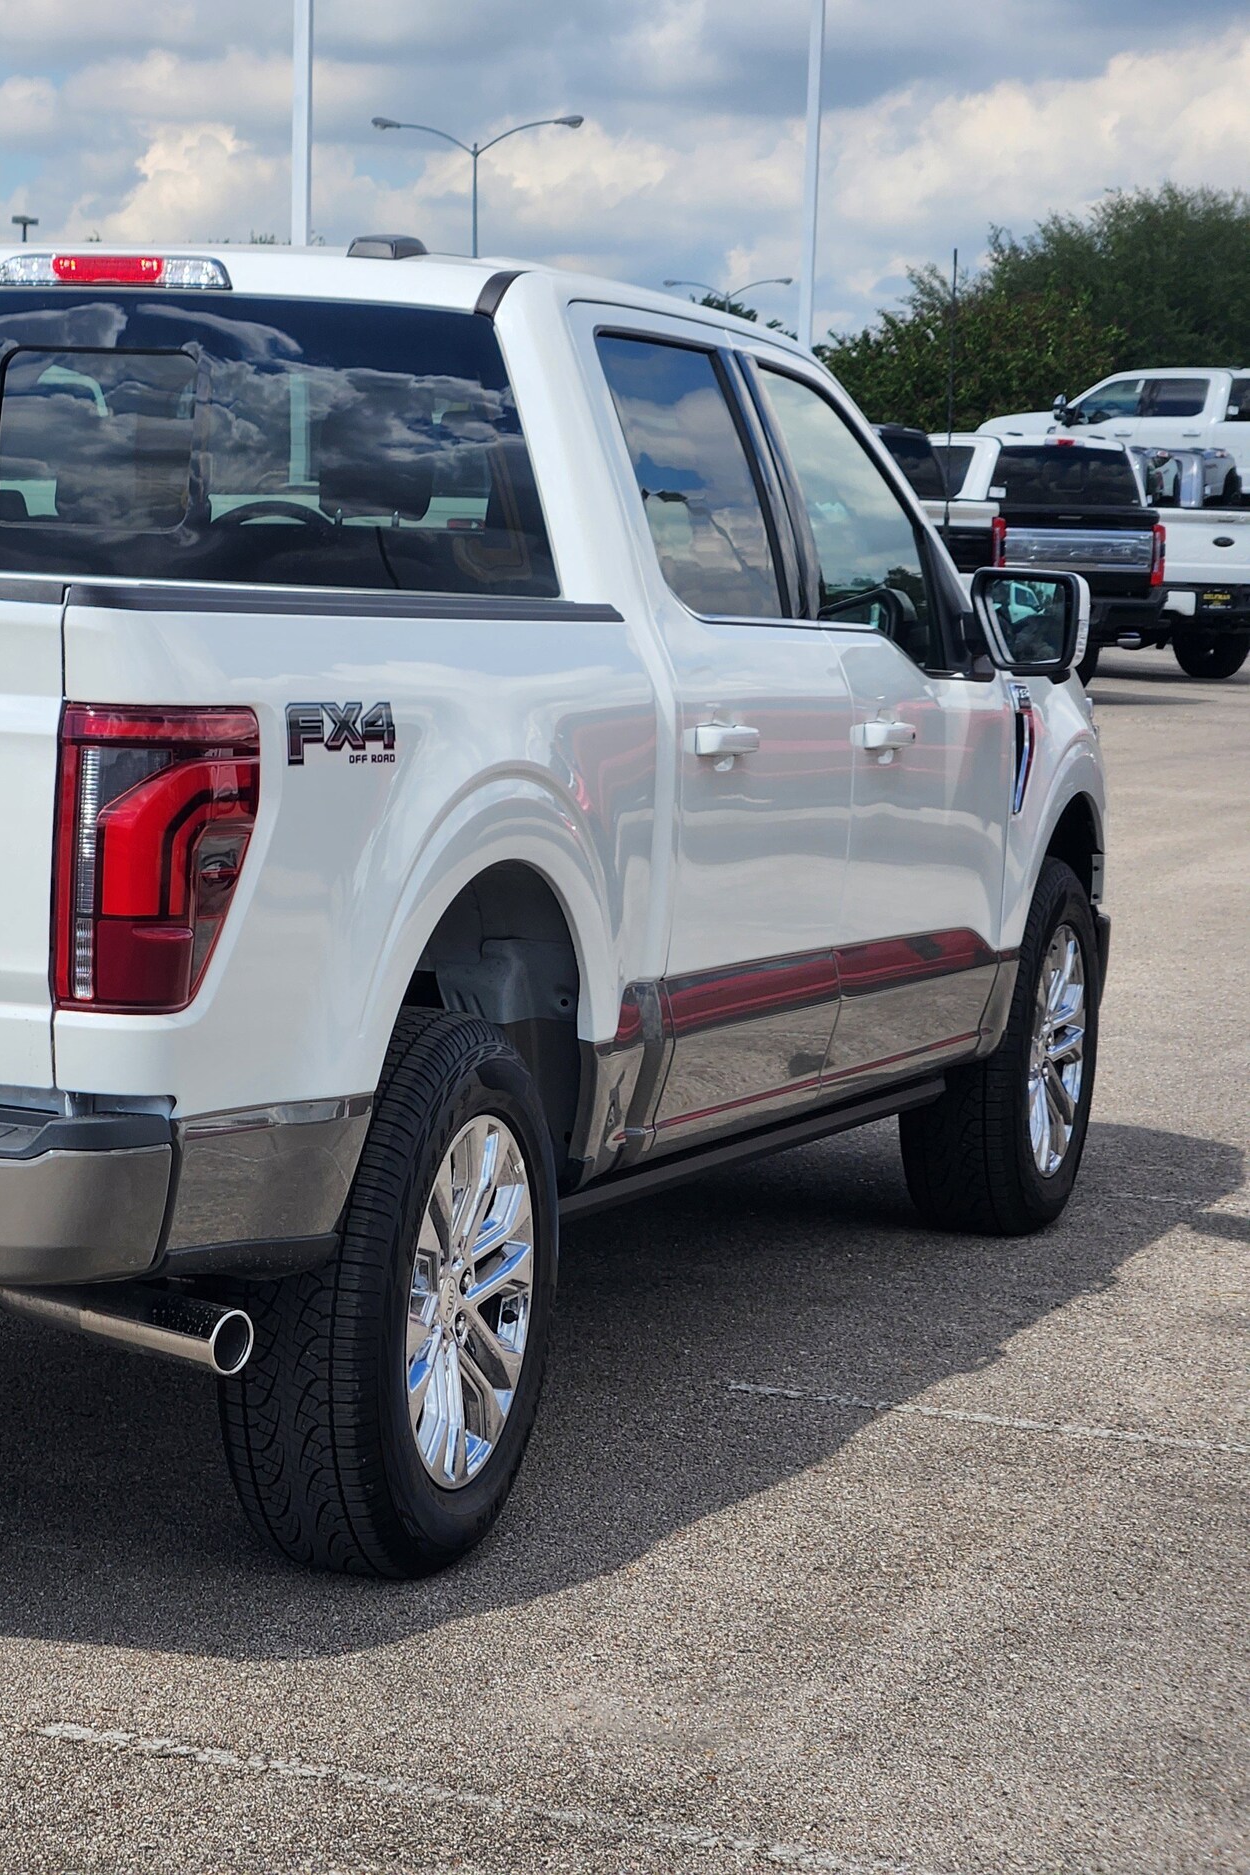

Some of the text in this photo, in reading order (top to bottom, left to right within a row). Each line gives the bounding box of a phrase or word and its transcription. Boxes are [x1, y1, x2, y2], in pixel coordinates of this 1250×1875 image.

[285, 701, 396, 766] FX4
[349, 753, 395, 764] OFF ROAD
